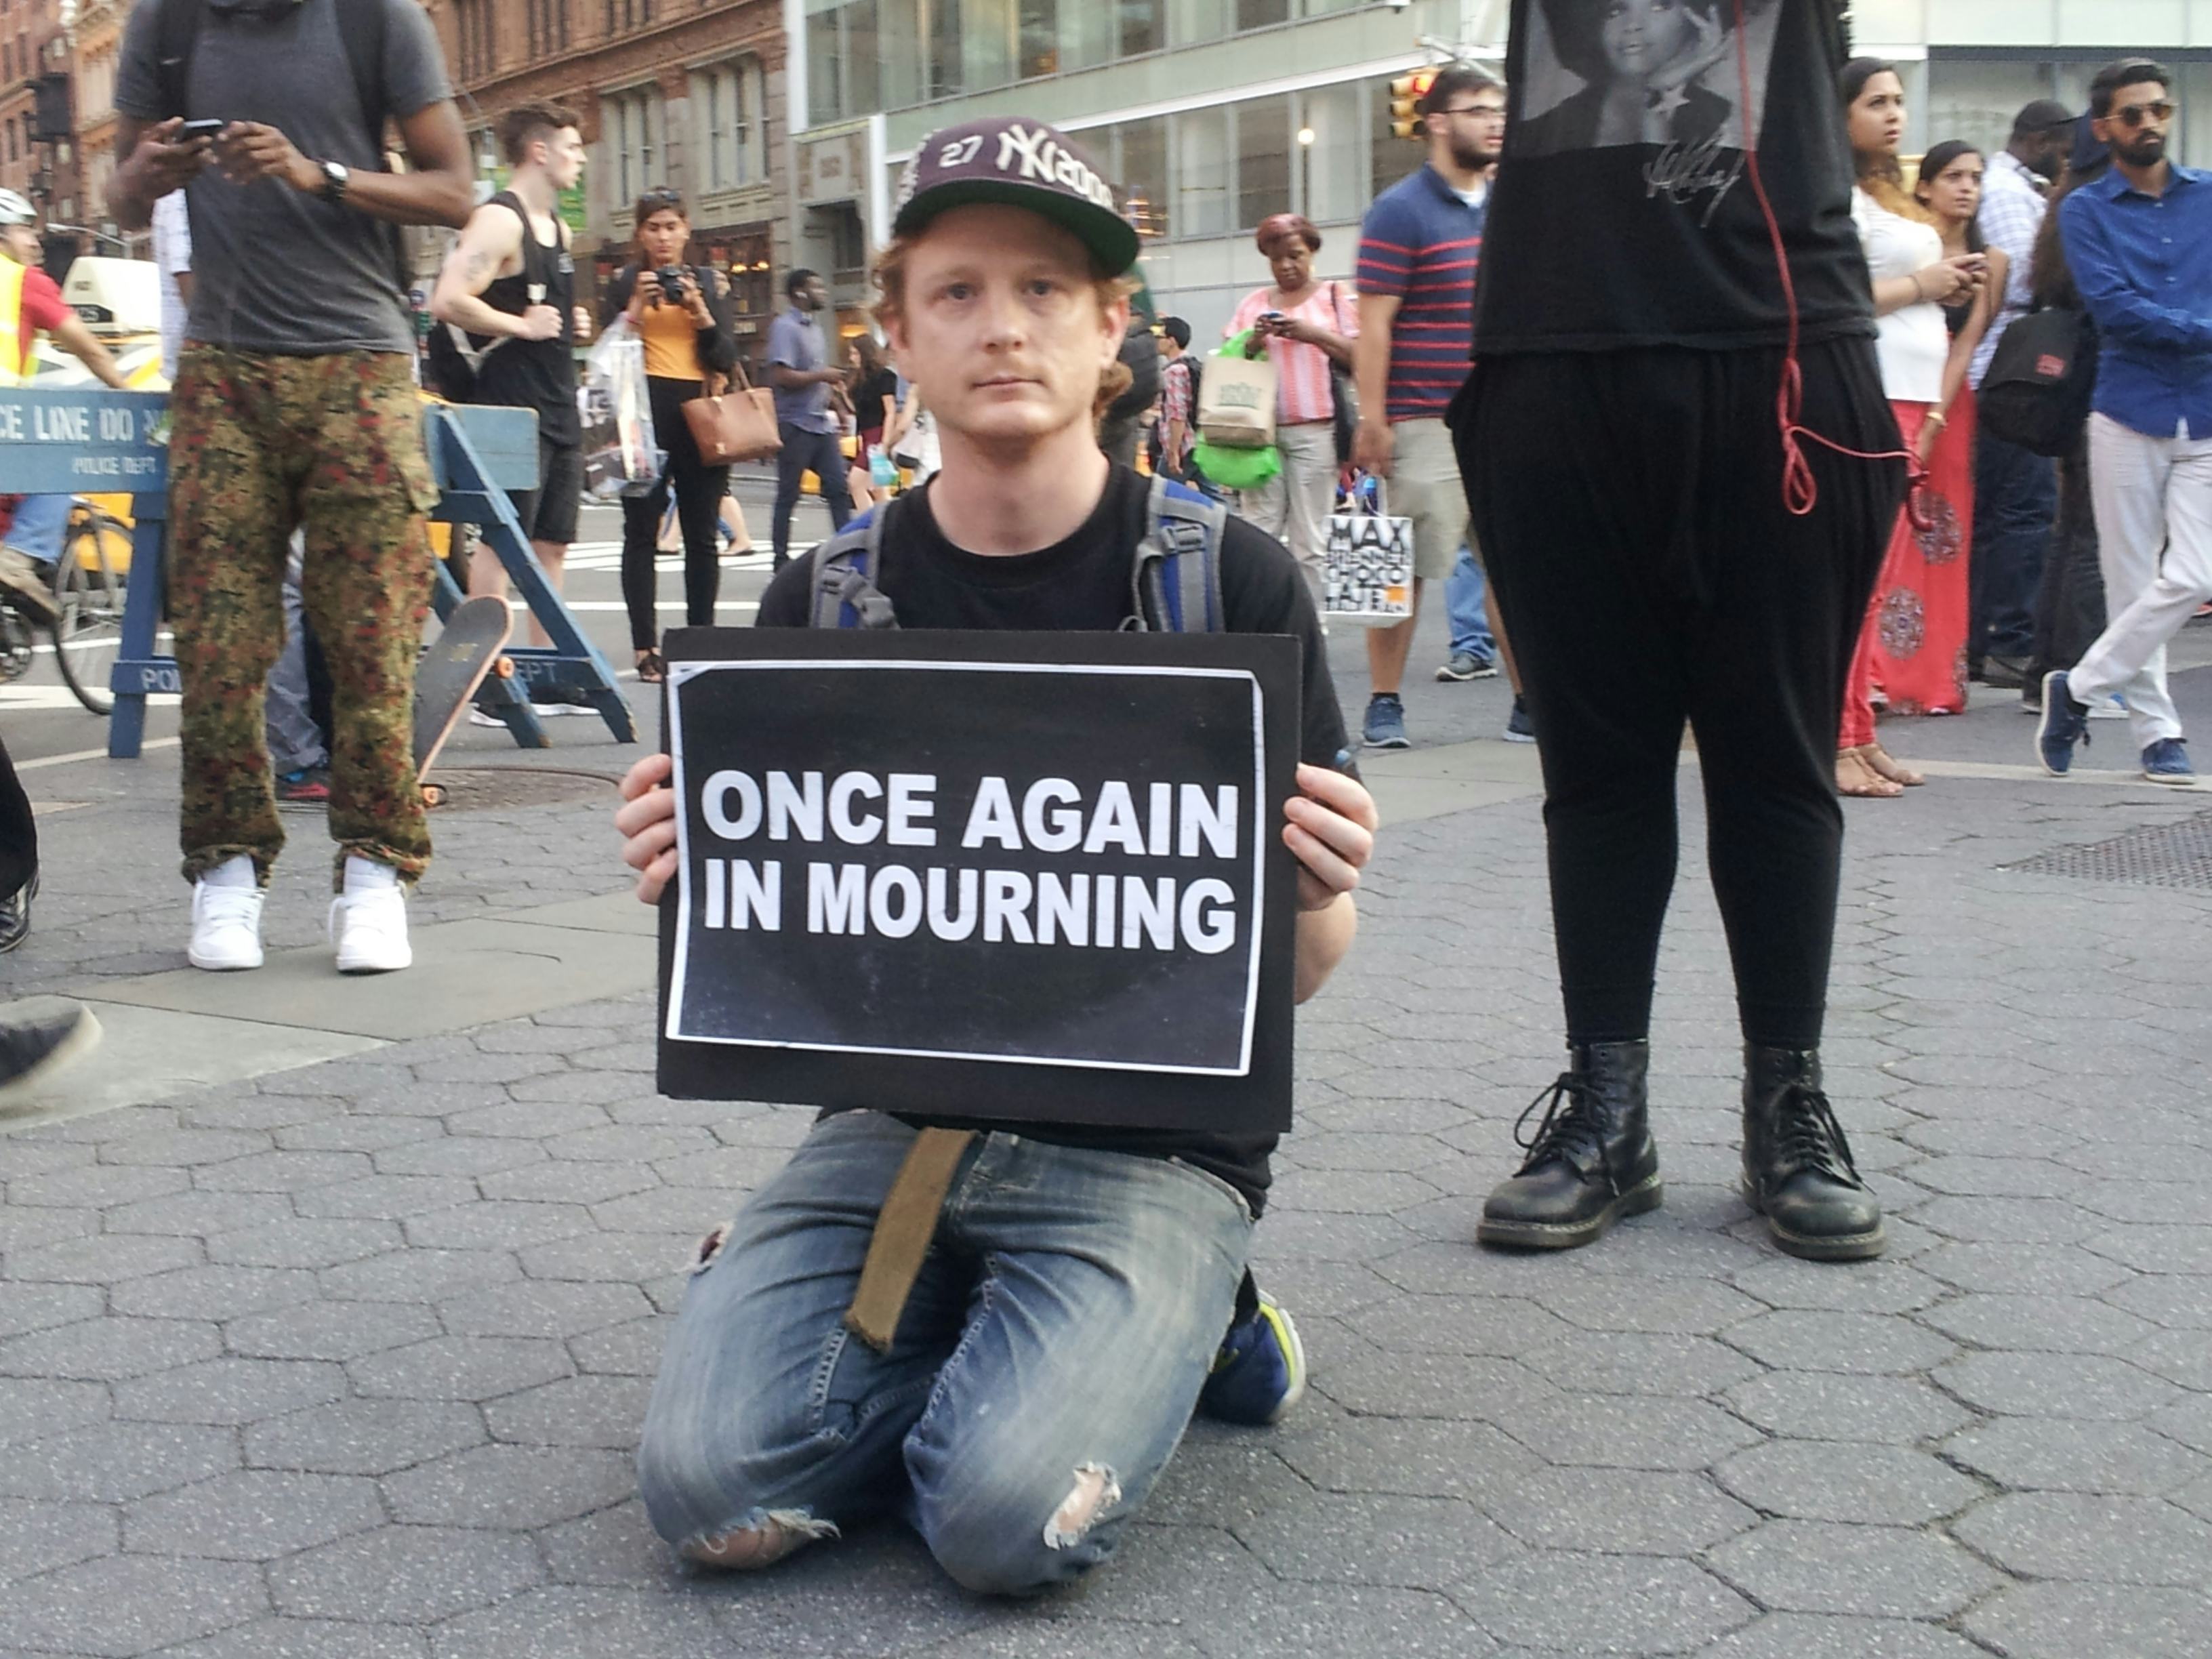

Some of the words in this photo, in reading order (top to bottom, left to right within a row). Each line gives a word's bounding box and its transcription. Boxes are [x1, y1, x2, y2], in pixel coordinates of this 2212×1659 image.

[939, 135, 983, 167] 27
[996, 124, 1056, 183] NY
[34, 405, 91, 441] LINE
[99, 407, 134, 441] DO
[72, 457, 119, 474] POLICE
[1327, 516, 1406, 553] MAX
[701, 770, 937, 846] ONCE
[961, 776, 1238, 859] AGAIN
[705, 859, 781, 931] IN
[807, 862, 1236, 954] MOURNING
